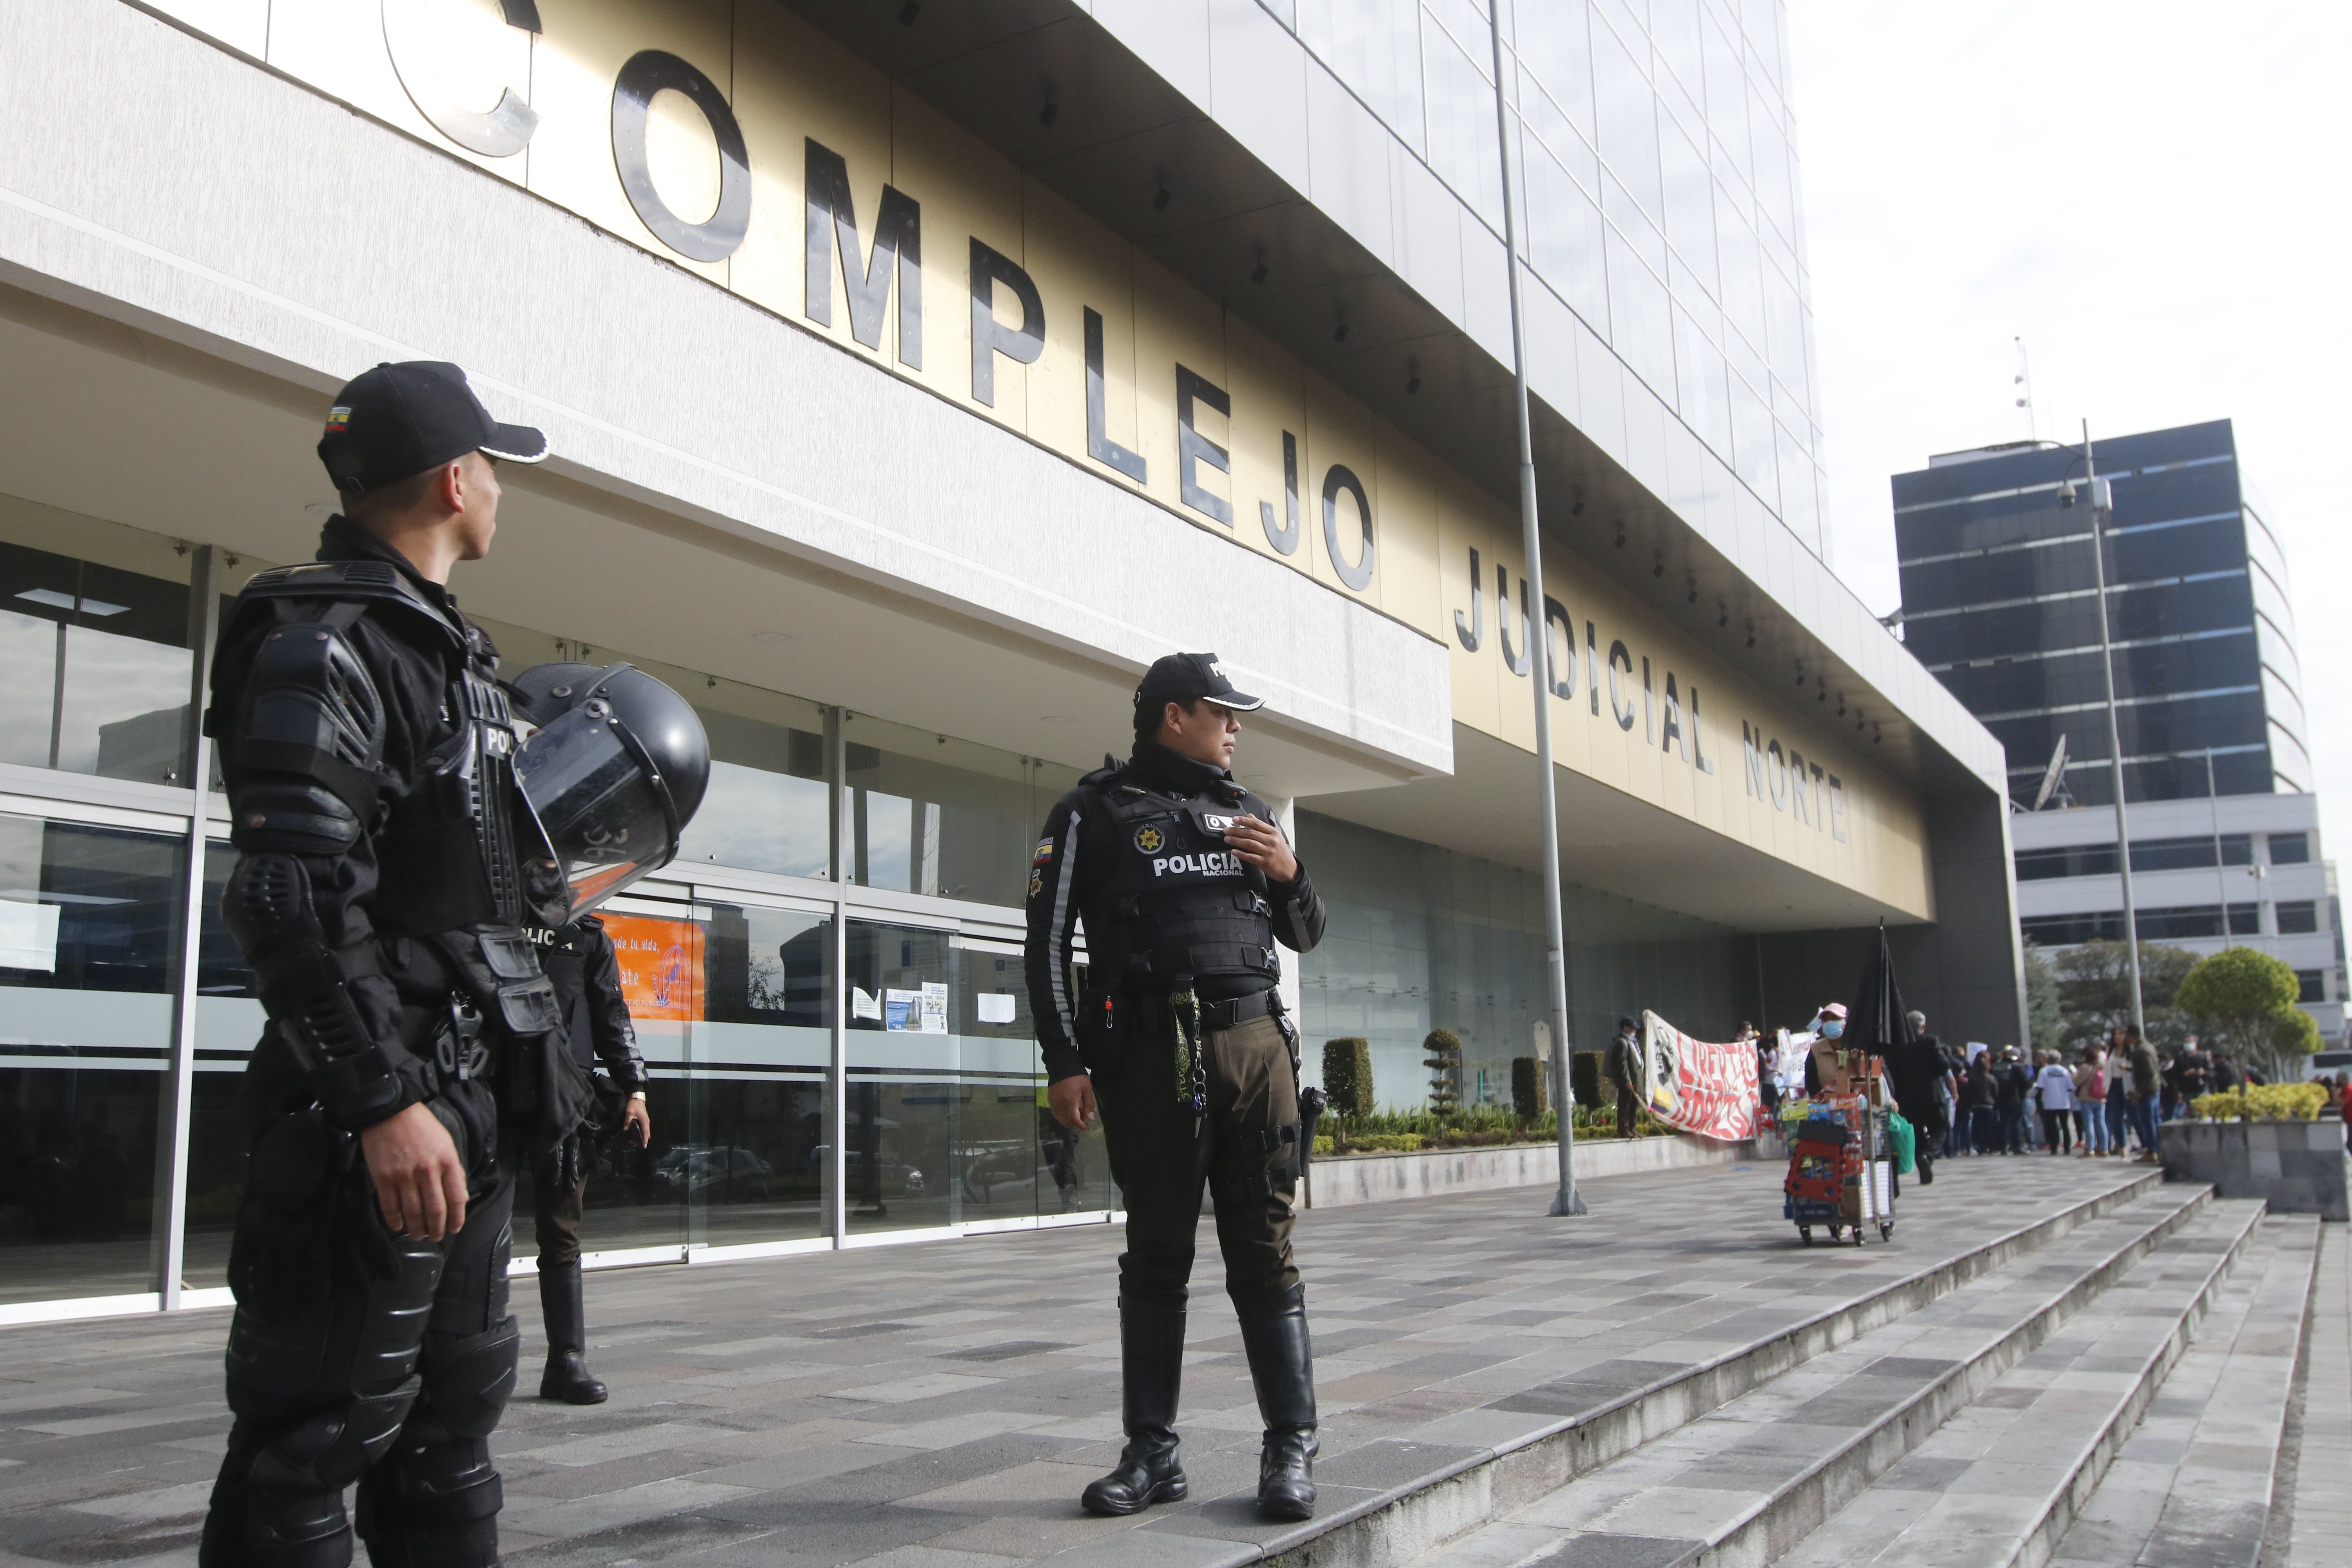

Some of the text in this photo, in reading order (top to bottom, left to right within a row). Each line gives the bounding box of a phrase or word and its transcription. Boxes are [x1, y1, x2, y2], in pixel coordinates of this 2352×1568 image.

[381, 0, 1846, 844] COMPLEJO JUDICIAL NORTE
[1153, 853, 1243, 877] POLICIA
[613, 936, 626, 949] nde
[630, 938, 638, 950] tu
[621, 969, 639, 985] ate
